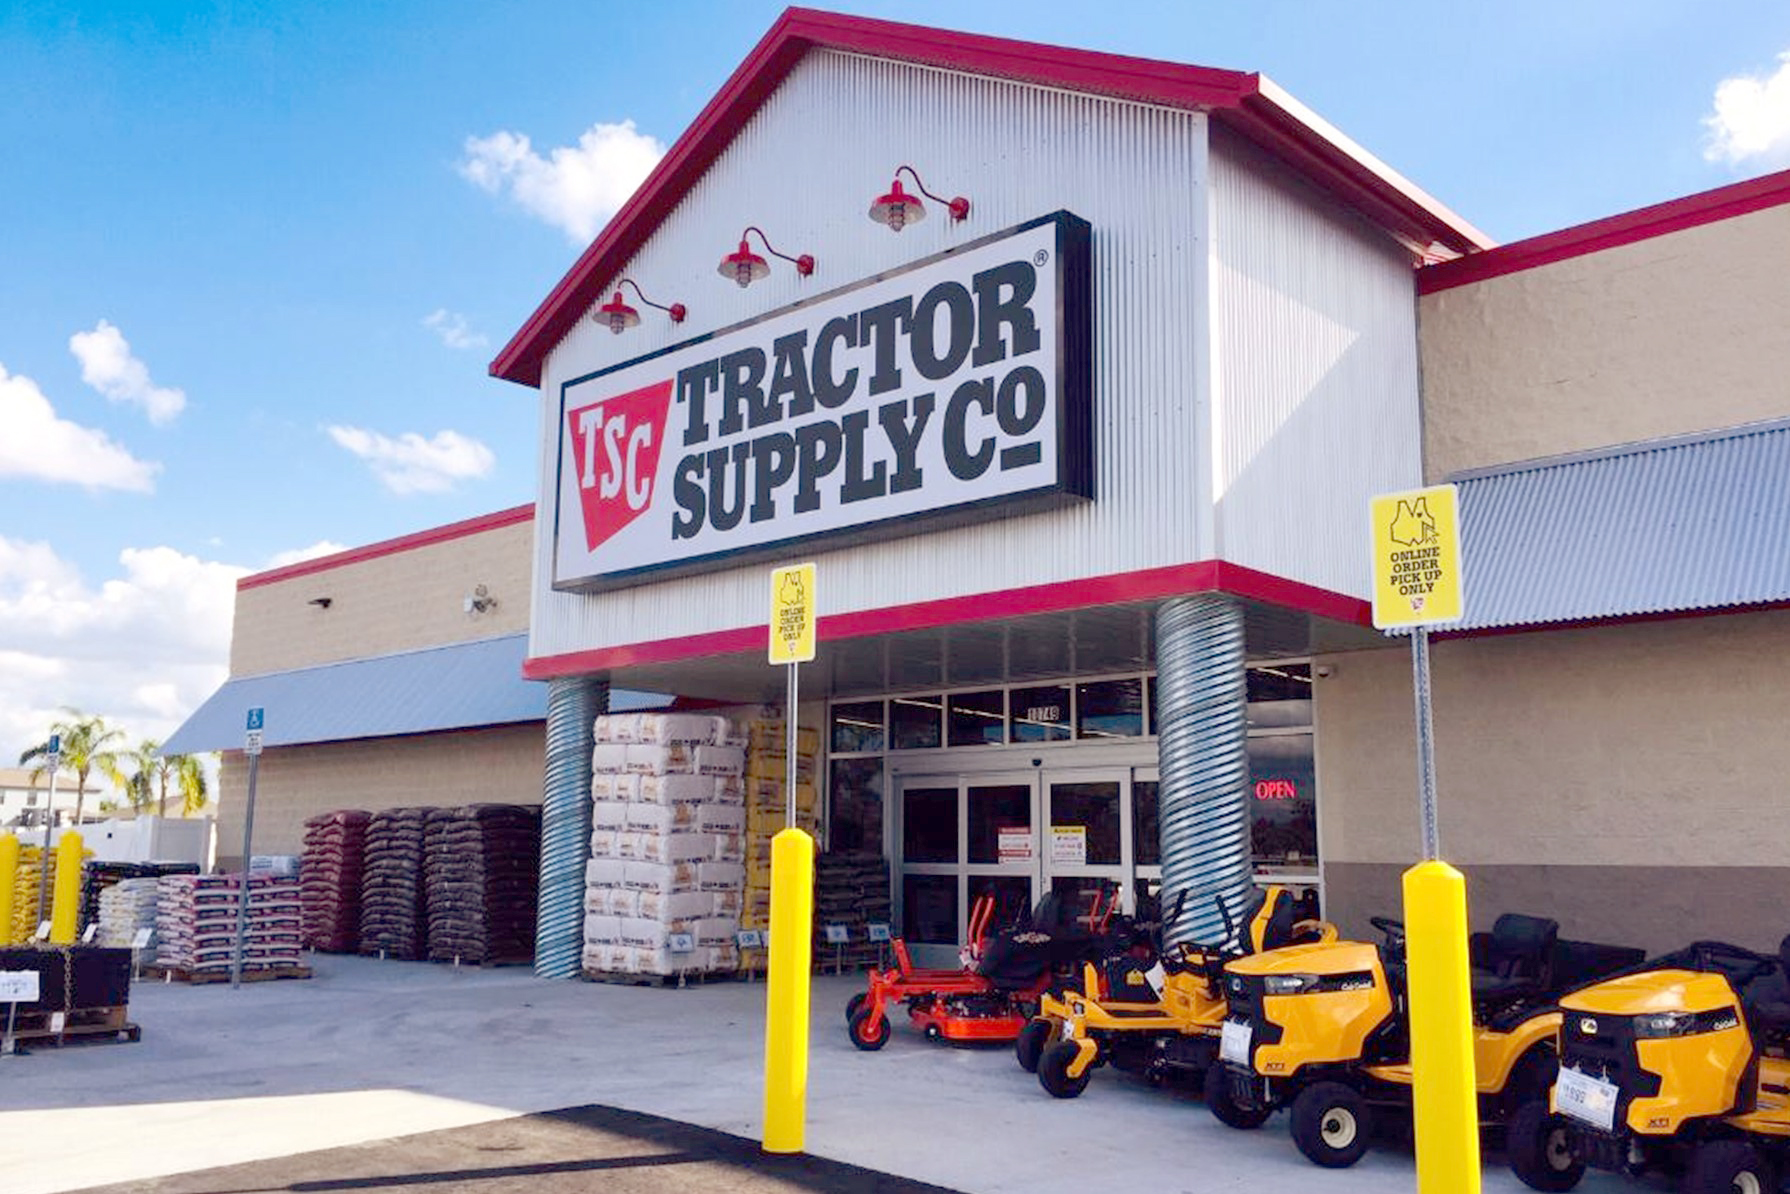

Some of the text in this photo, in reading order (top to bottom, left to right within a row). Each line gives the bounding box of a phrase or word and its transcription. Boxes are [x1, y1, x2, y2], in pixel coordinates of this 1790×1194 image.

[676, 260, 1041, 446] TRACTOR
[578, 406, 652, 511] TSC
[672, 393, 936, 541] SUPPLY
[1390, 547, 1441, 563] ONLINE
[1392, 559, 1439, 574] ORDER
[1390, 570, 1443, 586] PICK UP
[1399, 583, 1435, 596] ONLY
[1256, 780, 1295, 799] OPEN
